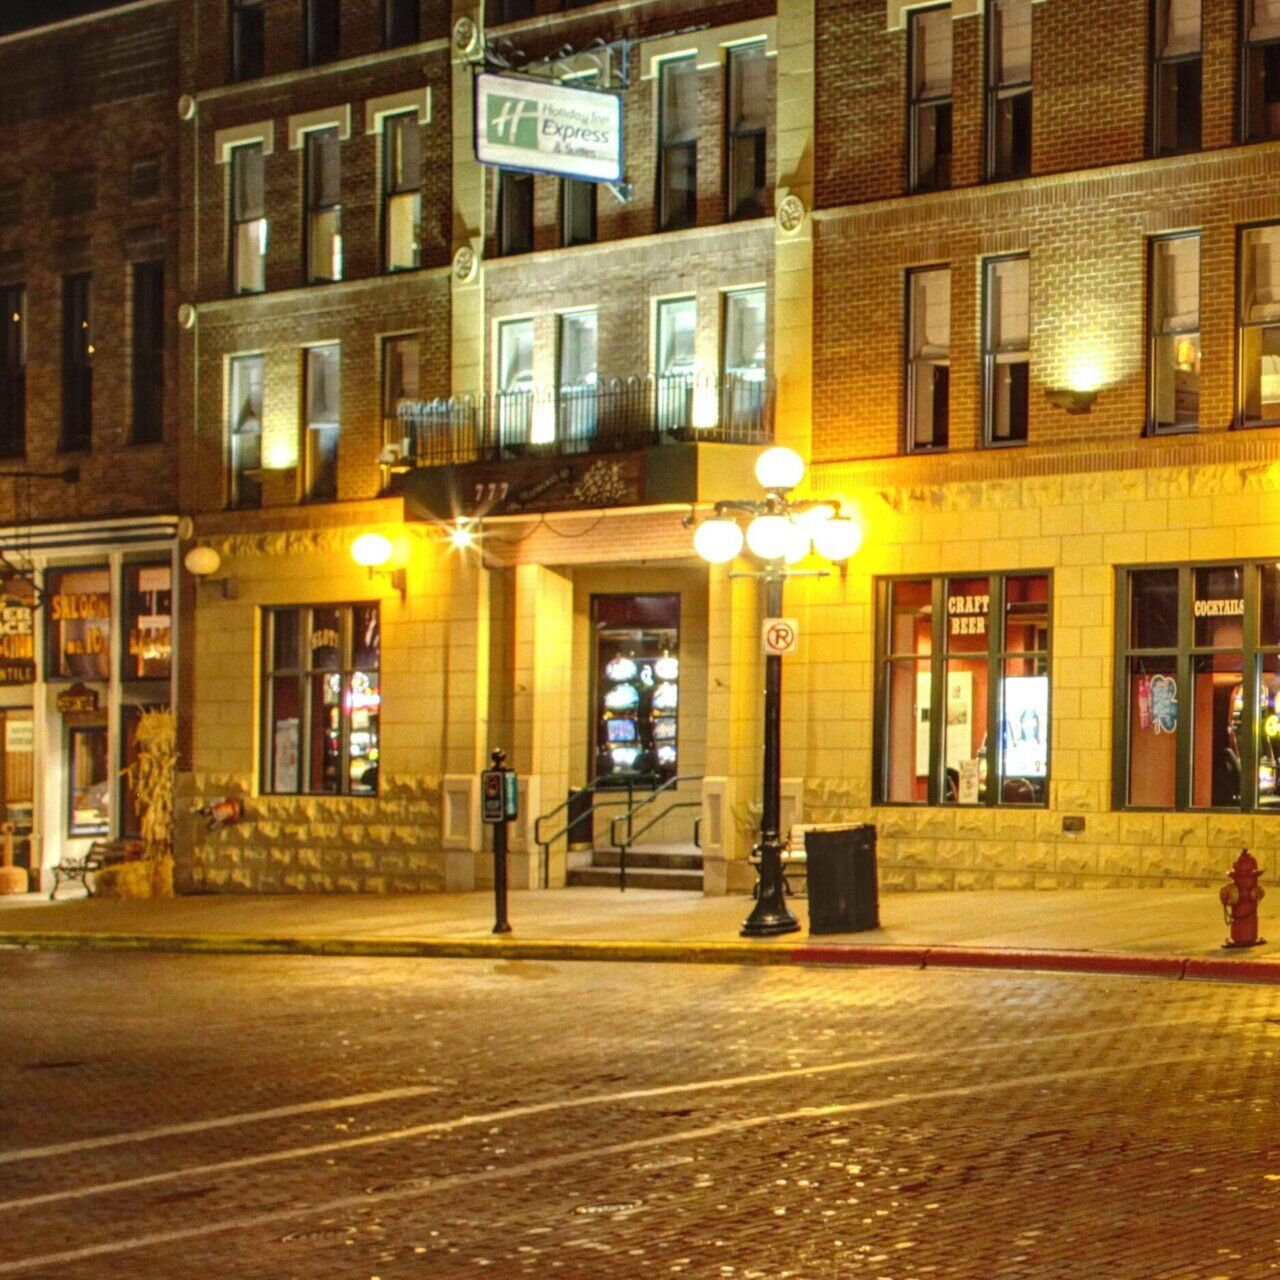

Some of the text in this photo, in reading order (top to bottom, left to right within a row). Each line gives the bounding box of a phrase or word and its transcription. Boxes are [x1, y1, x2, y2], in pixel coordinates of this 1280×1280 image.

[543, 103, 610, 125] Holiday Inn
[542, 120, 609, 143] Express
[565, 143, 596, 157] Suites
[948, 595, 990, 614] CRAFT
[1194, 599, 1244, 616] COCKTAILS
[951, 617, 985, 634] BEER
